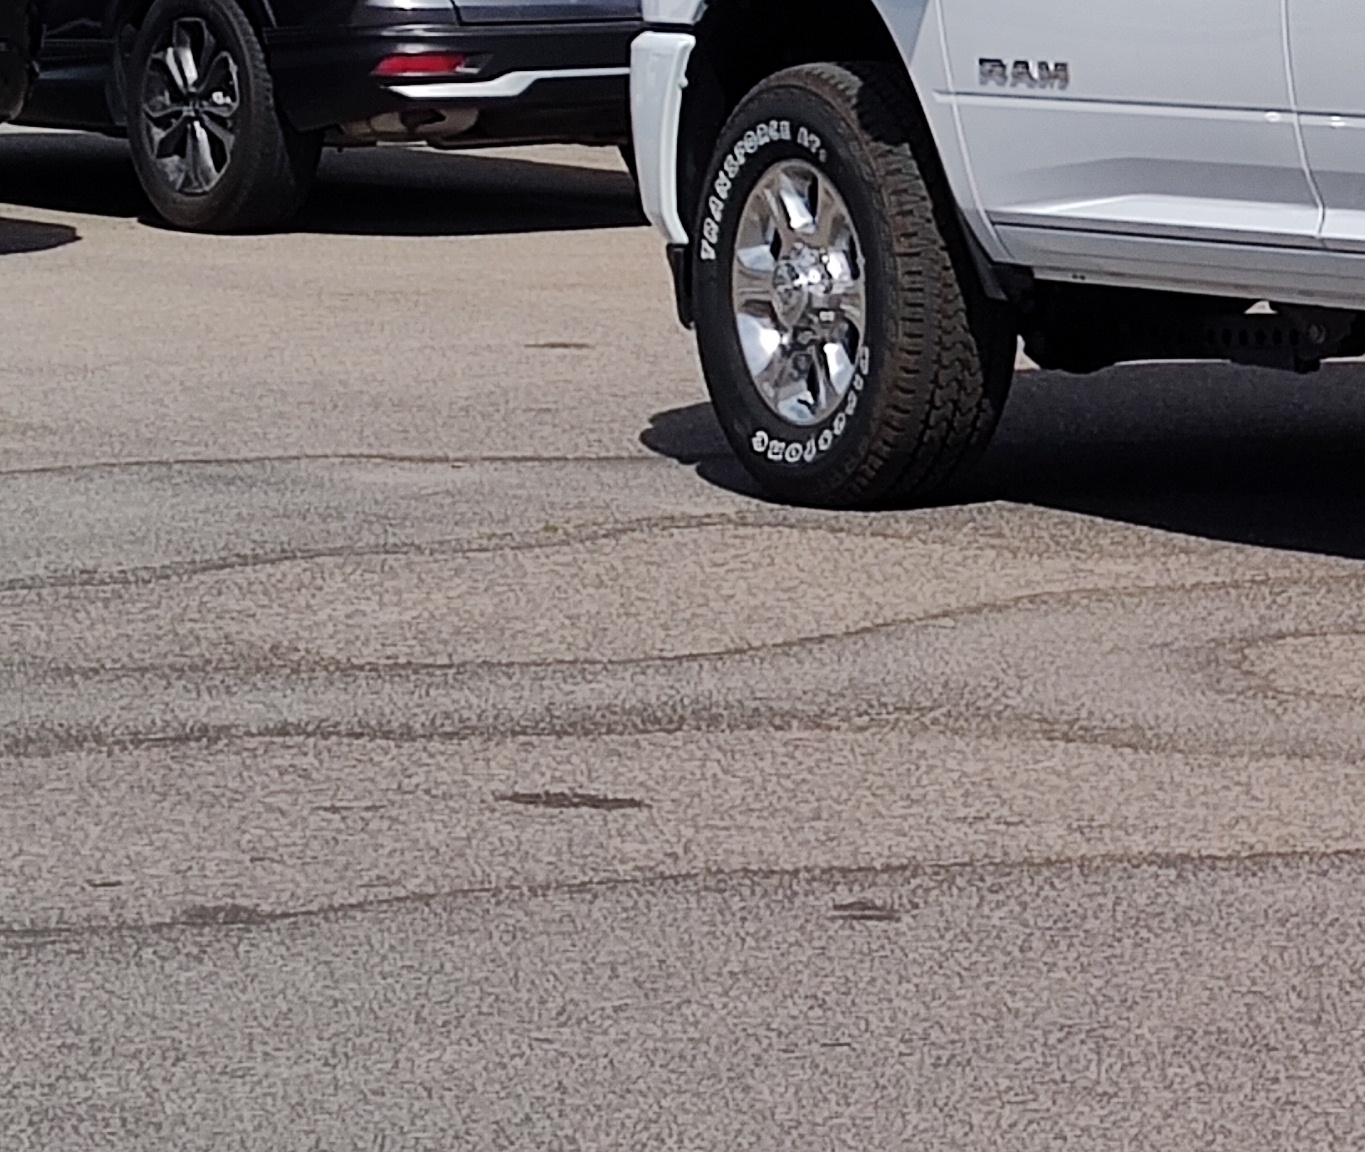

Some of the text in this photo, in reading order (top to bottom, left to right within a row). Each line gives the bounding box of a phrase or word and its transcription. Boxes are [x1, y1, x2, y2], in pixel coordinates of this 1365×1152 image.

[978, 57, 1069, 90] RAM
[700, 119, 792, 261] TRANSFORCE
[751, 345, 871, 463] FIRESTONE
